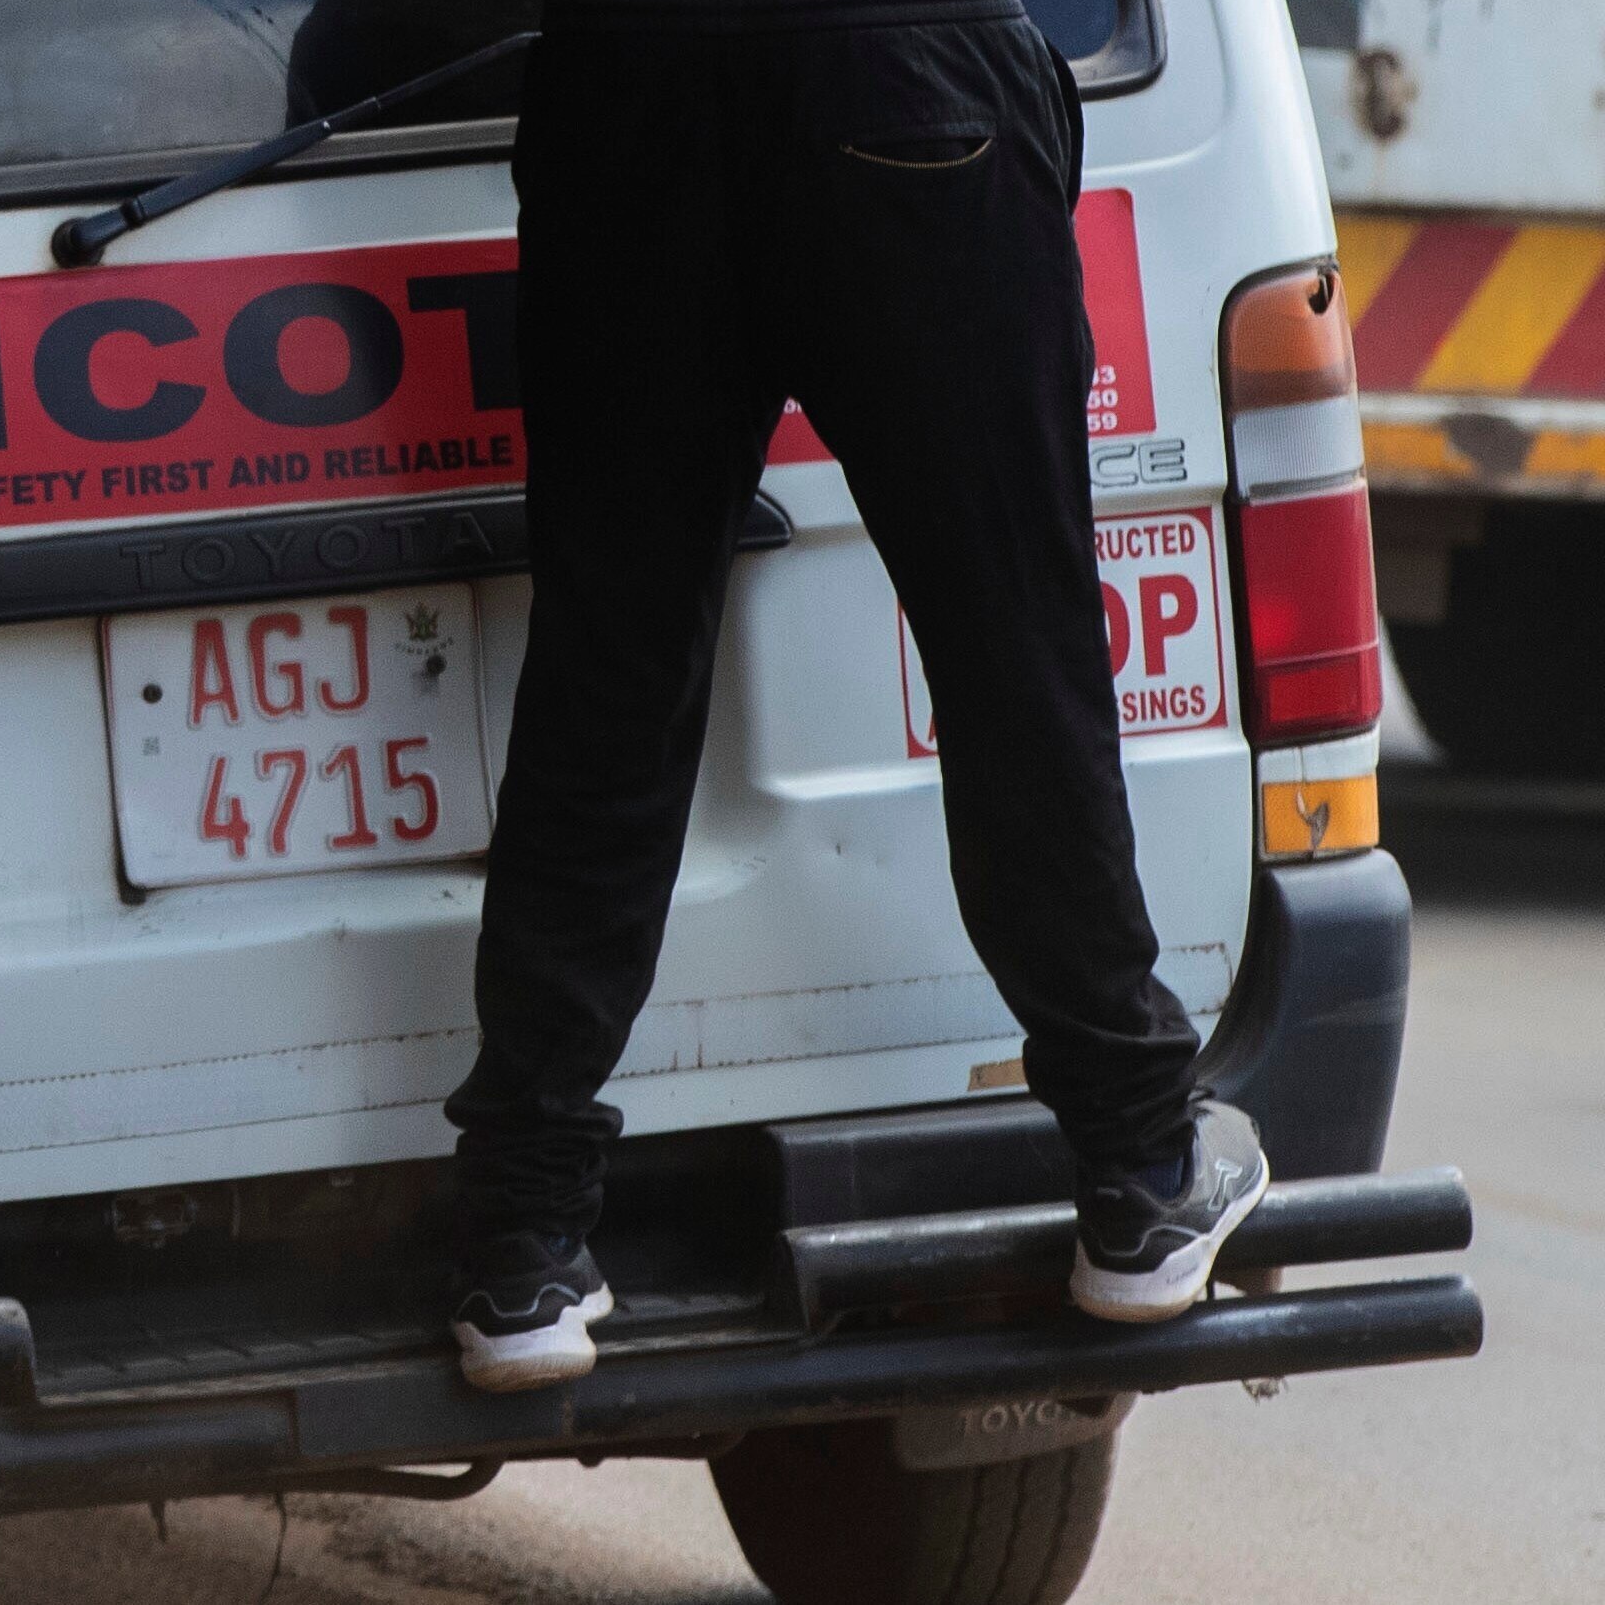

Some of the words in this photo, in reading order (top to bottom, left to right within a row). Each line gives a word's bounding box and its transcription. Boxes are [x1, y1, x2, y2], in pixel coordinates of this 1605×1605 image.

[101, 459, 214, 499] FIRST
[228, 450, 310, 490] AND
[325, 436, 513, 479] RELIABLE
[118, 511, 495, 590] TOYOTA
[188, 605, 371, 728] AGJ
[1120, 685, 1207, 724] SINGS
[200, 738, 441, 860] 4715
